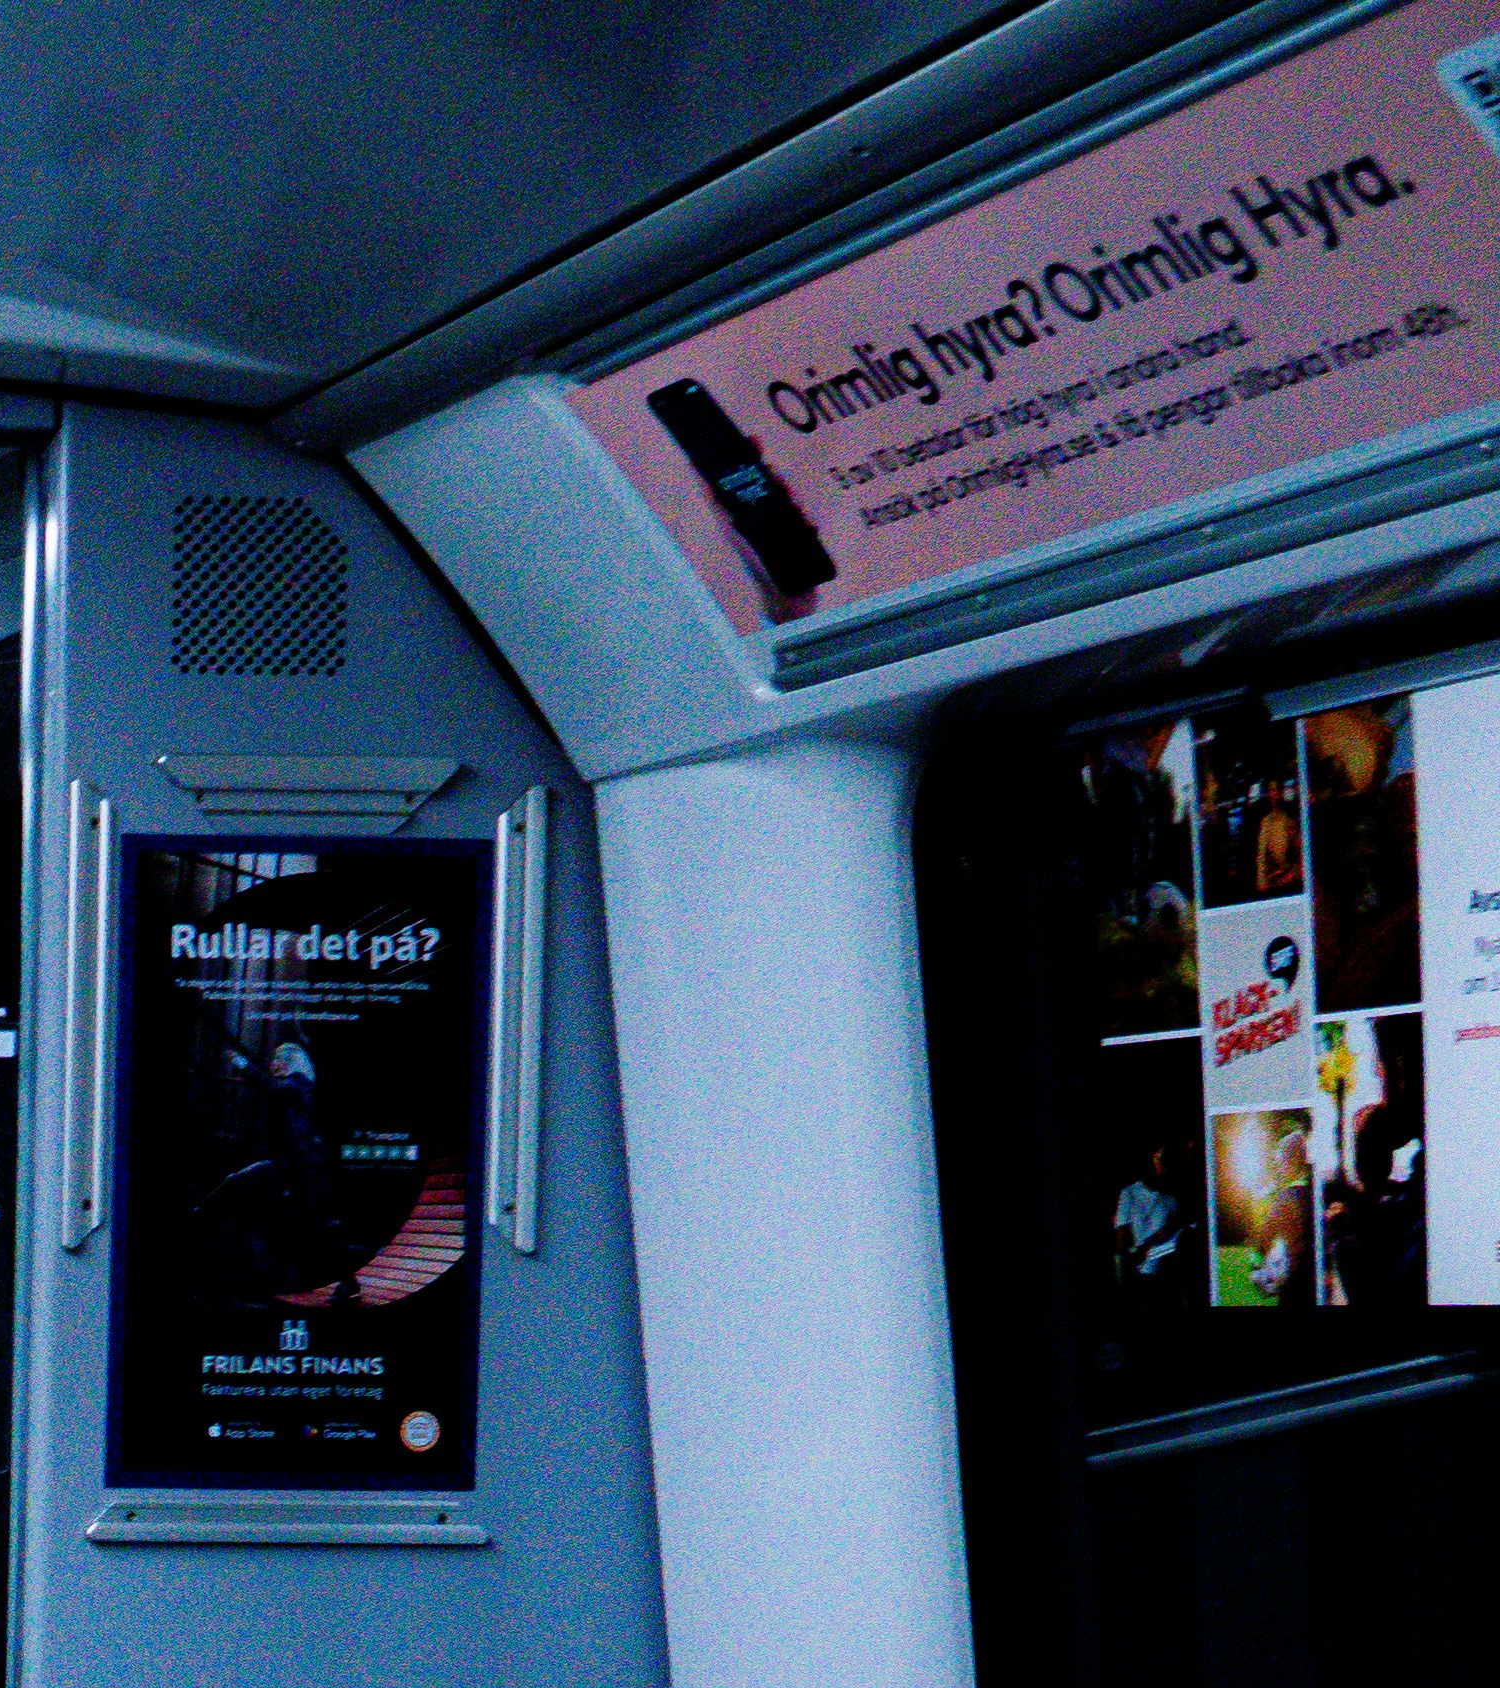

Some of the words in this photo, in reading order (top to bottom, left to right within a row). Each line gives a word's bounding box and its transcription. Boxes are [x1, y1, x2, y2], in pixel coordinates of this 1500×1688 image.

[768, 340, 941, 434] Orimlig
[910, 279, 1057, 383] hyra?
[1046, 212, 1258, 325] Orimlig
[1231, 152, 1417, 252] Hyra.
[170, 922, 292, 960] Rullar
[296, 923, 361, 962] det
[369, 926, 441, 970] på?
[201, 1354, 297, 1375] FRILANS
[300, 1355, 386, 1377] FINANS
